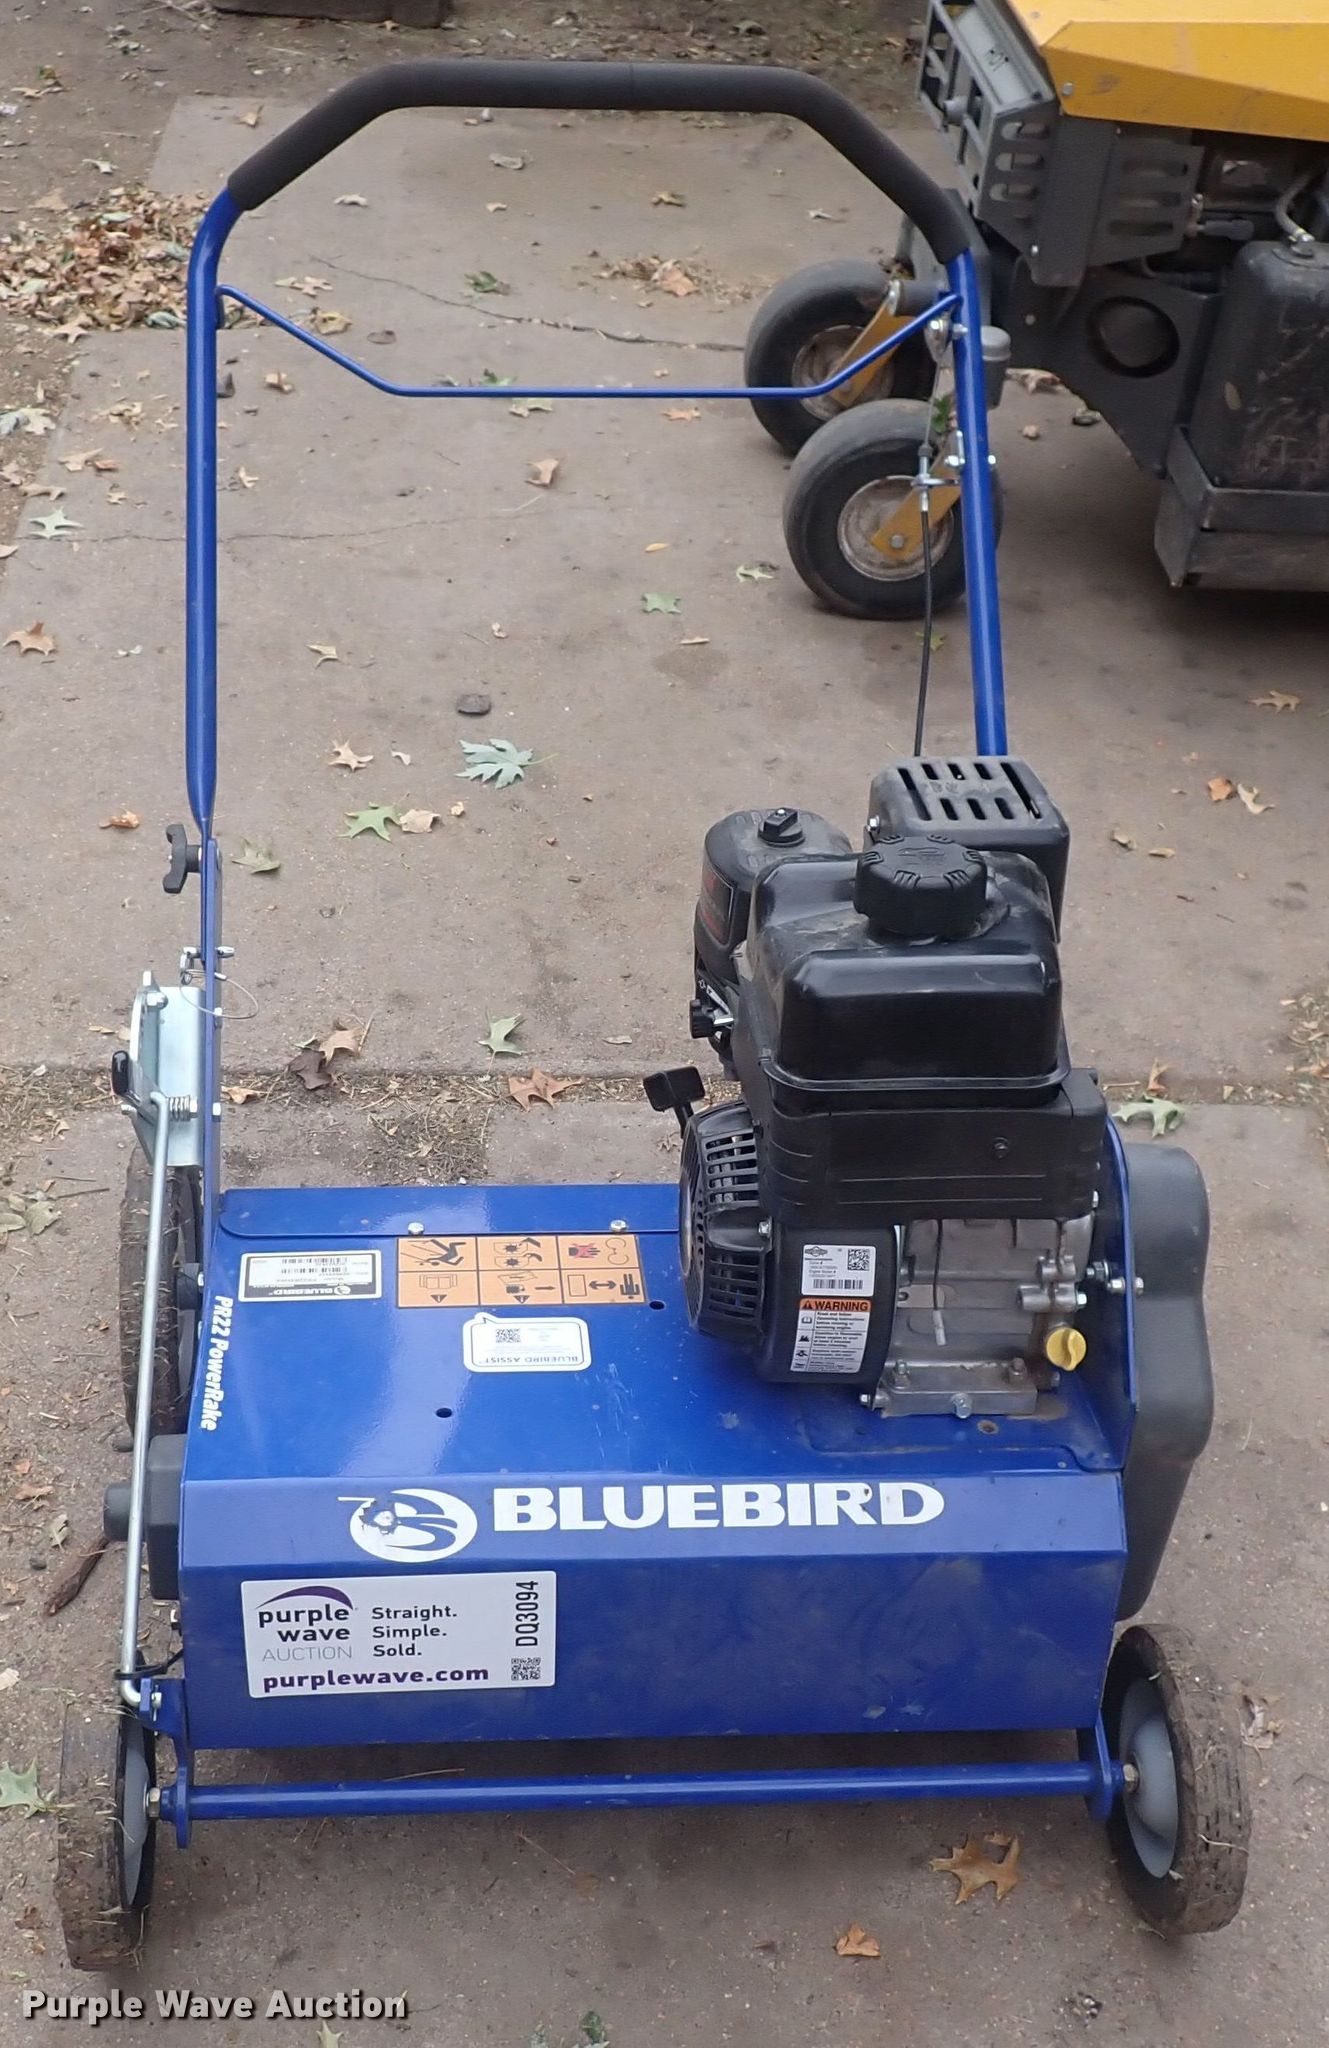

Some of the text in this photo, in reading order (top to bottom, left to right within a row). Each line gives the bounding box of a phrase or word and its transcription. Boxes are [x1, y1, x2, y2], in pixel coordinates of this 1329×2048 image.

[814, 1301, 868, 1312] WARNING
[200, 1338, 229, 1431] PowerRake
[493, 1482, 945, 1532] BLUEBIRD
[258, 1603, 350, 1628] purple
[371, 1604, 458, 1622] Straight.
[515, 1580, 540, 1647] DQ3094
[277, 1627, 350, 1642] wave
[372, 1624, 447, 1641] Simple.
[262, 1645, 353, 1662] AUCTION
[373, 1643, 423, 1657] Sold.
[263, 1669, 489, 1693] purplewave.com
